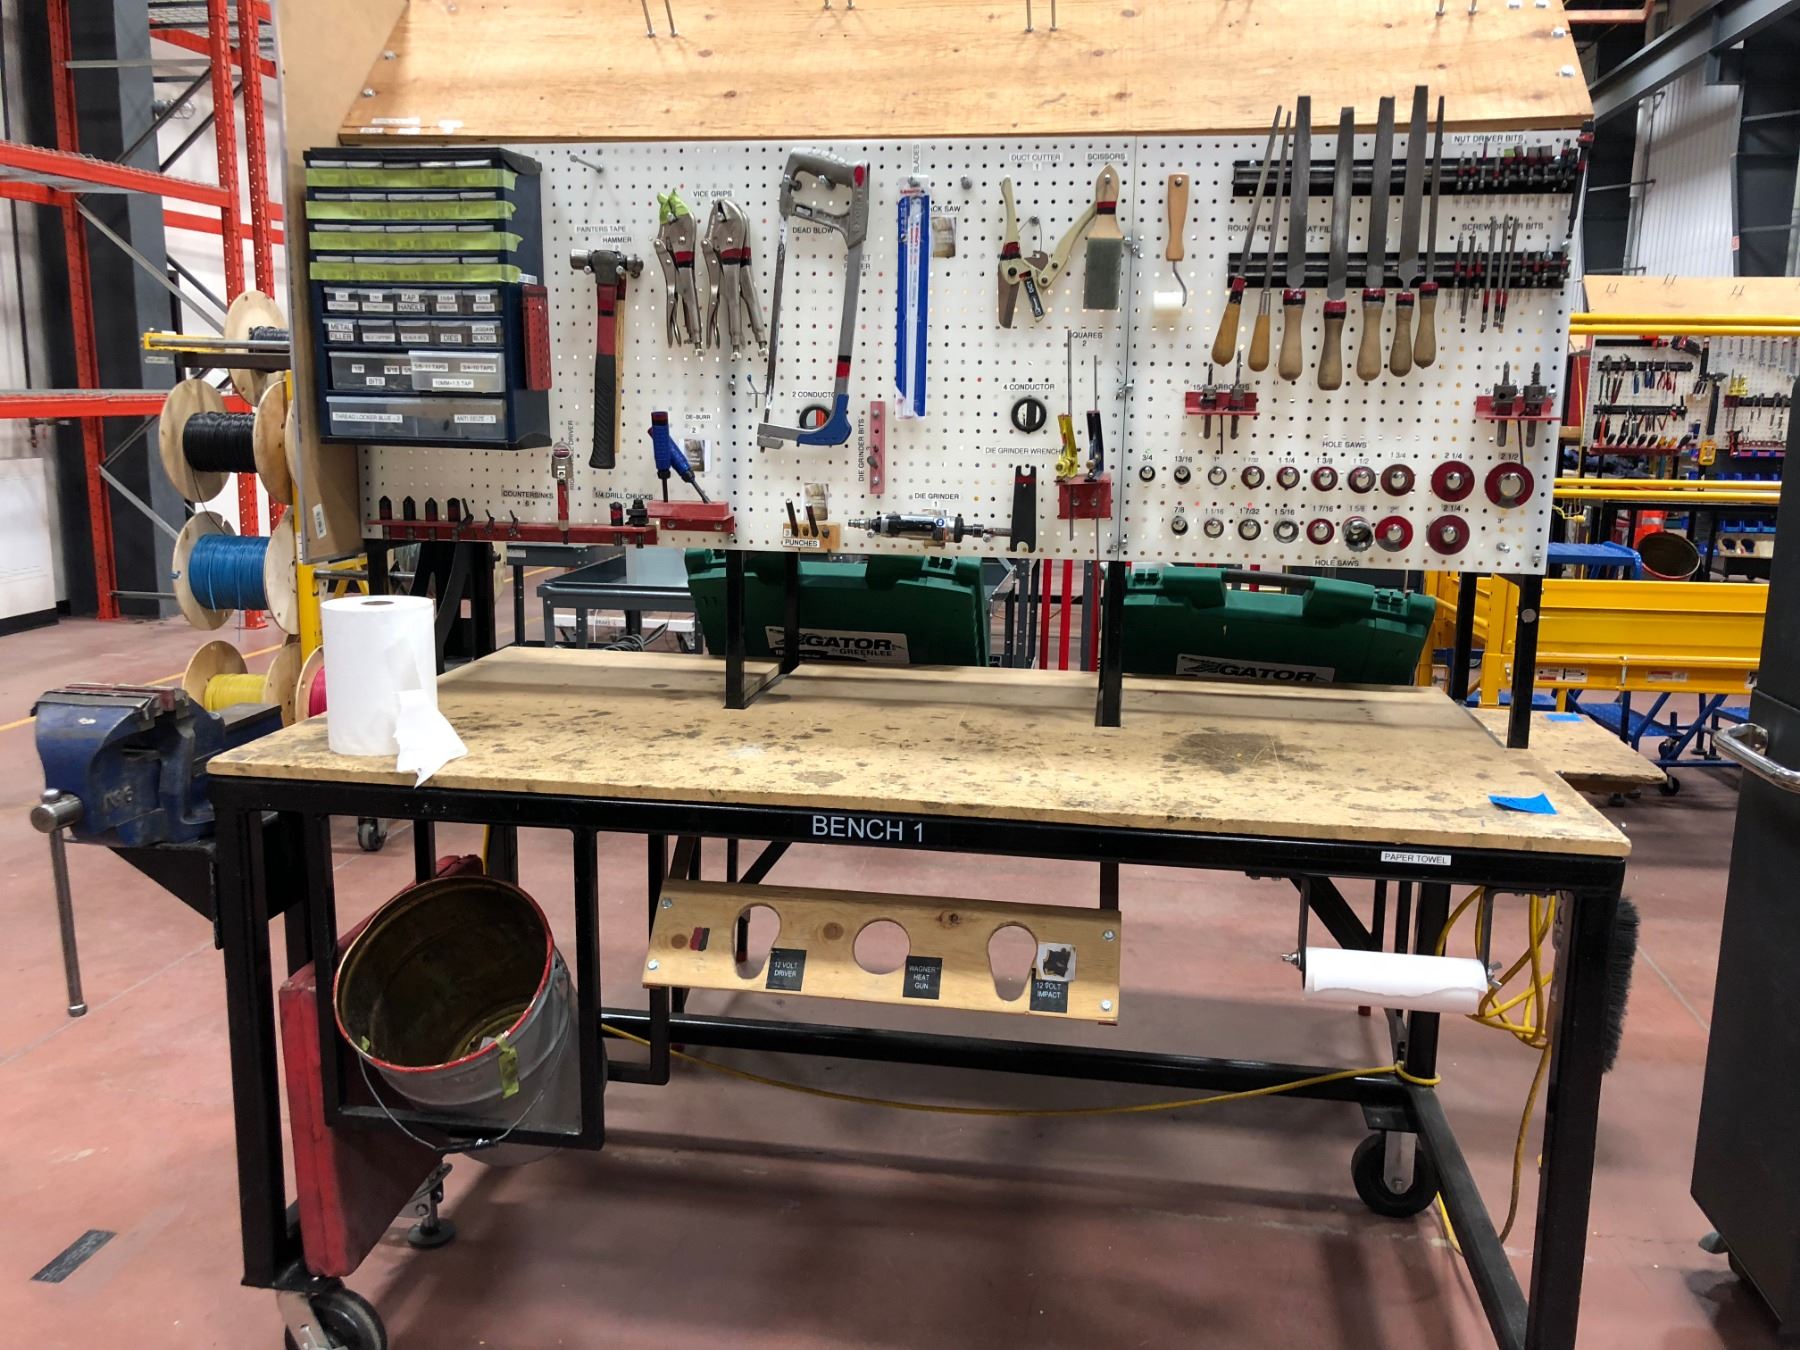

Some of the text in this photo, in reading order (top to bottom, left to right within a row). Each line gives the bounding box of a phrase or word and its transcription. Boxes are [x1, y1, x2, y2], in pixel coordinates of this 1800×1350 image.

[503, 490, 553, 499] COUNTERSINKS
[806, 636, 892, 650] GATOR
[1218, 665, 1316, 682] GATOR
[812, 815, 923, 842] BENCH 1
[1384, 853, 1448, 864] PAPER TOWEL
[1037, 991, 1061, 999] IMPACT
